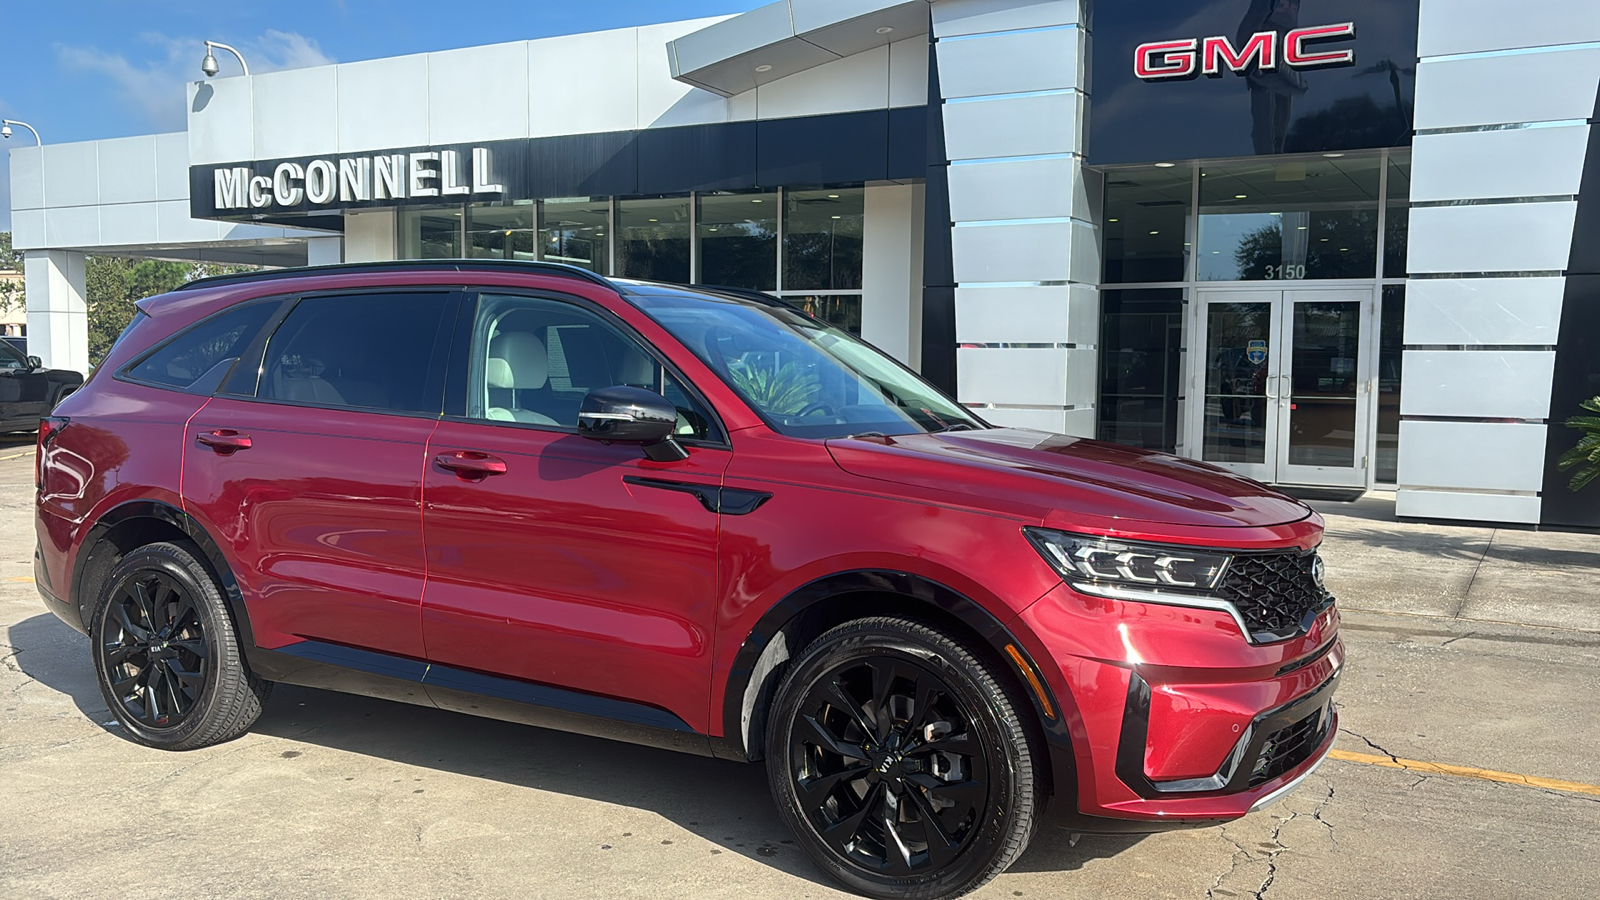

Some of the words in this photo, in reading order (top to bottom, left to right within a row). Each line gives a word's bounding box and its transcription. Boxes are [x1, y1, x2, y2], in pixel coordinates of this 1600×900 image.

[1134, 22, 1355, 80] GMC
[213, 147, 502, 210] McCONNELL
[1264, 264, 1306, 280] 3150
[150, 645, 161, 653] KIA
[879, 755, 894, 774] KIA
